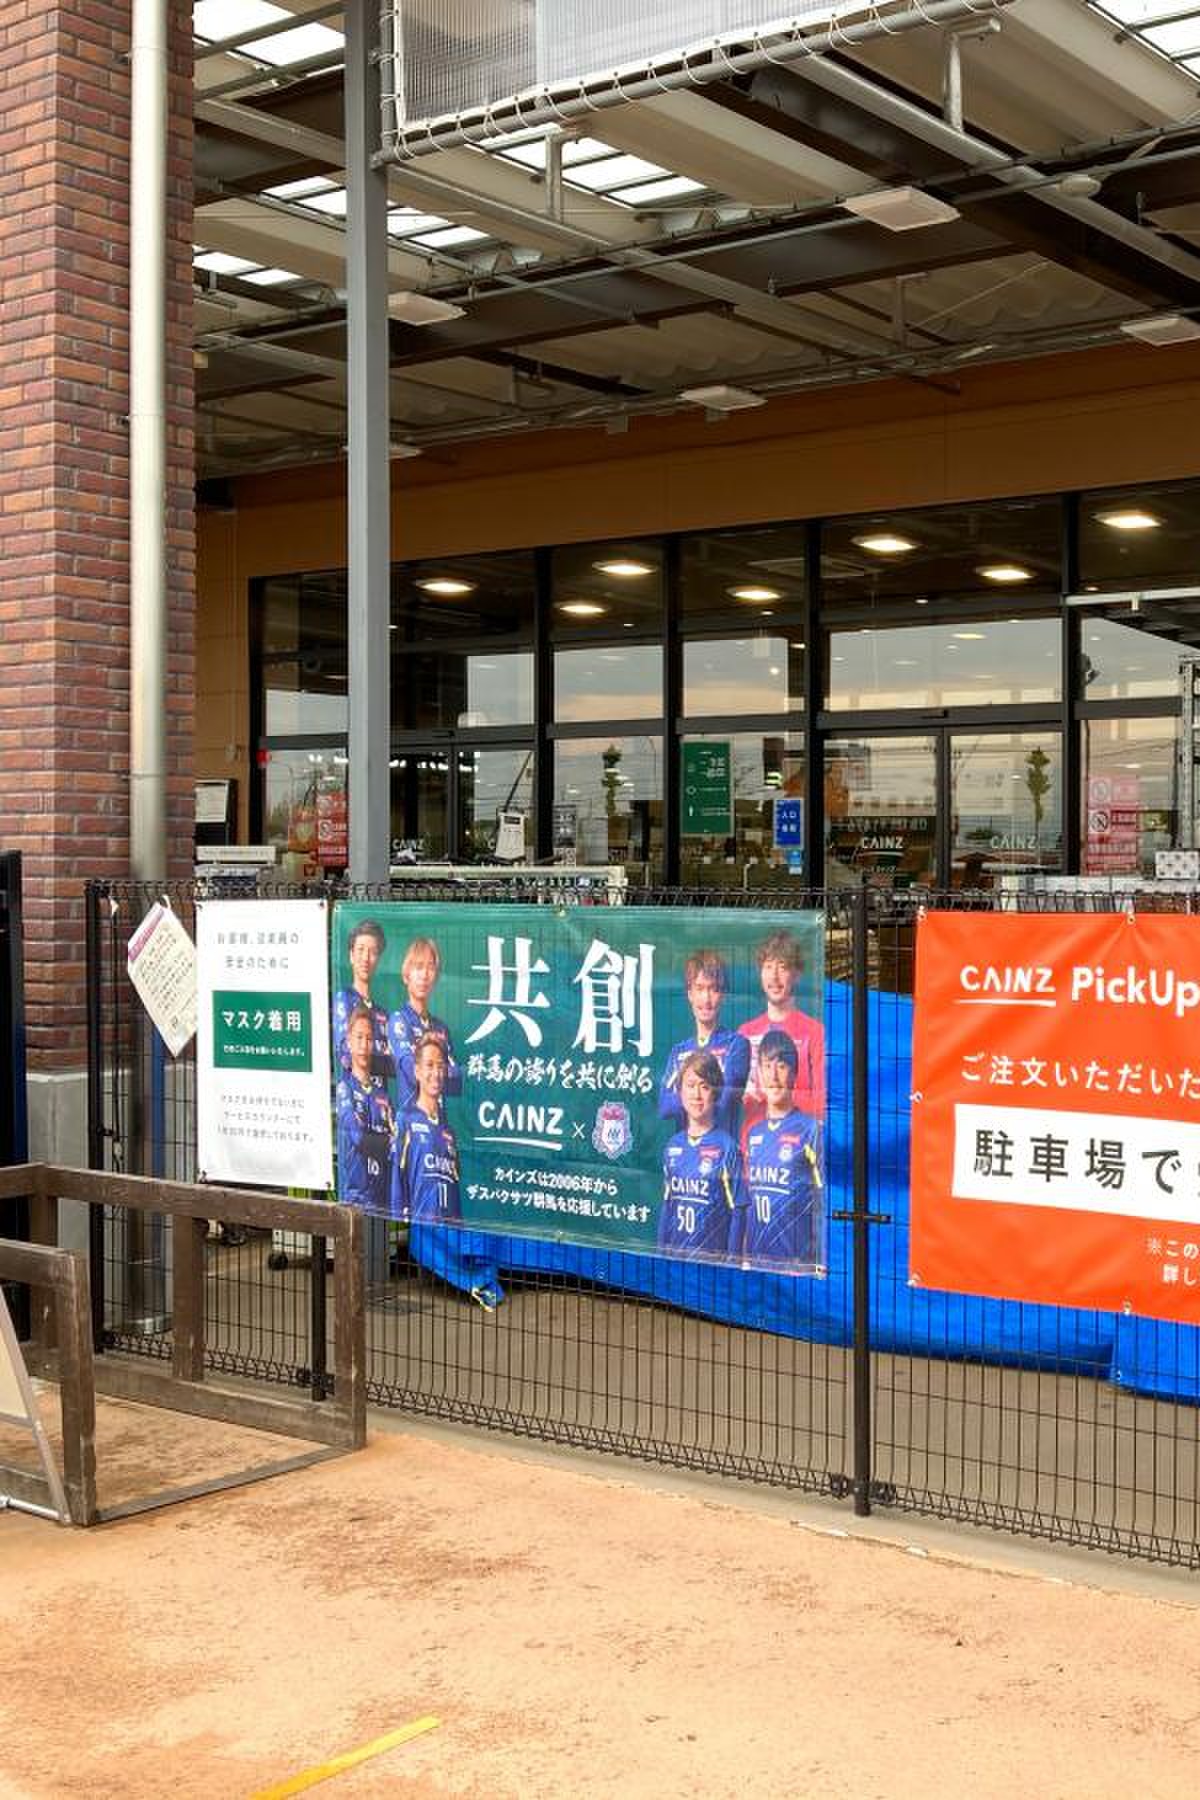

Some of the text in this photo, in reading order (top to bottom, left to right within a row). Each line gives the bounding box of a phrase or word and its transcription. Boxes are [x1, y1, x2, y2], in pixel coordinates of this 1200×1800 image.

[465, 936, 656, 1056] 共創
[960, 965, 1200, 1017] CAINZ PickUp
[221, 1009, 301, 1032] マスク着用
[478, 1101, 564, 1136] CAINZ
[495, 1166, 618, 1196] カインズは2006年から
[671, 1176, 710, 1197] CAINZ
[676, 1204, 695, 1233] 50
[755, 1194, 772, 1224] 10
